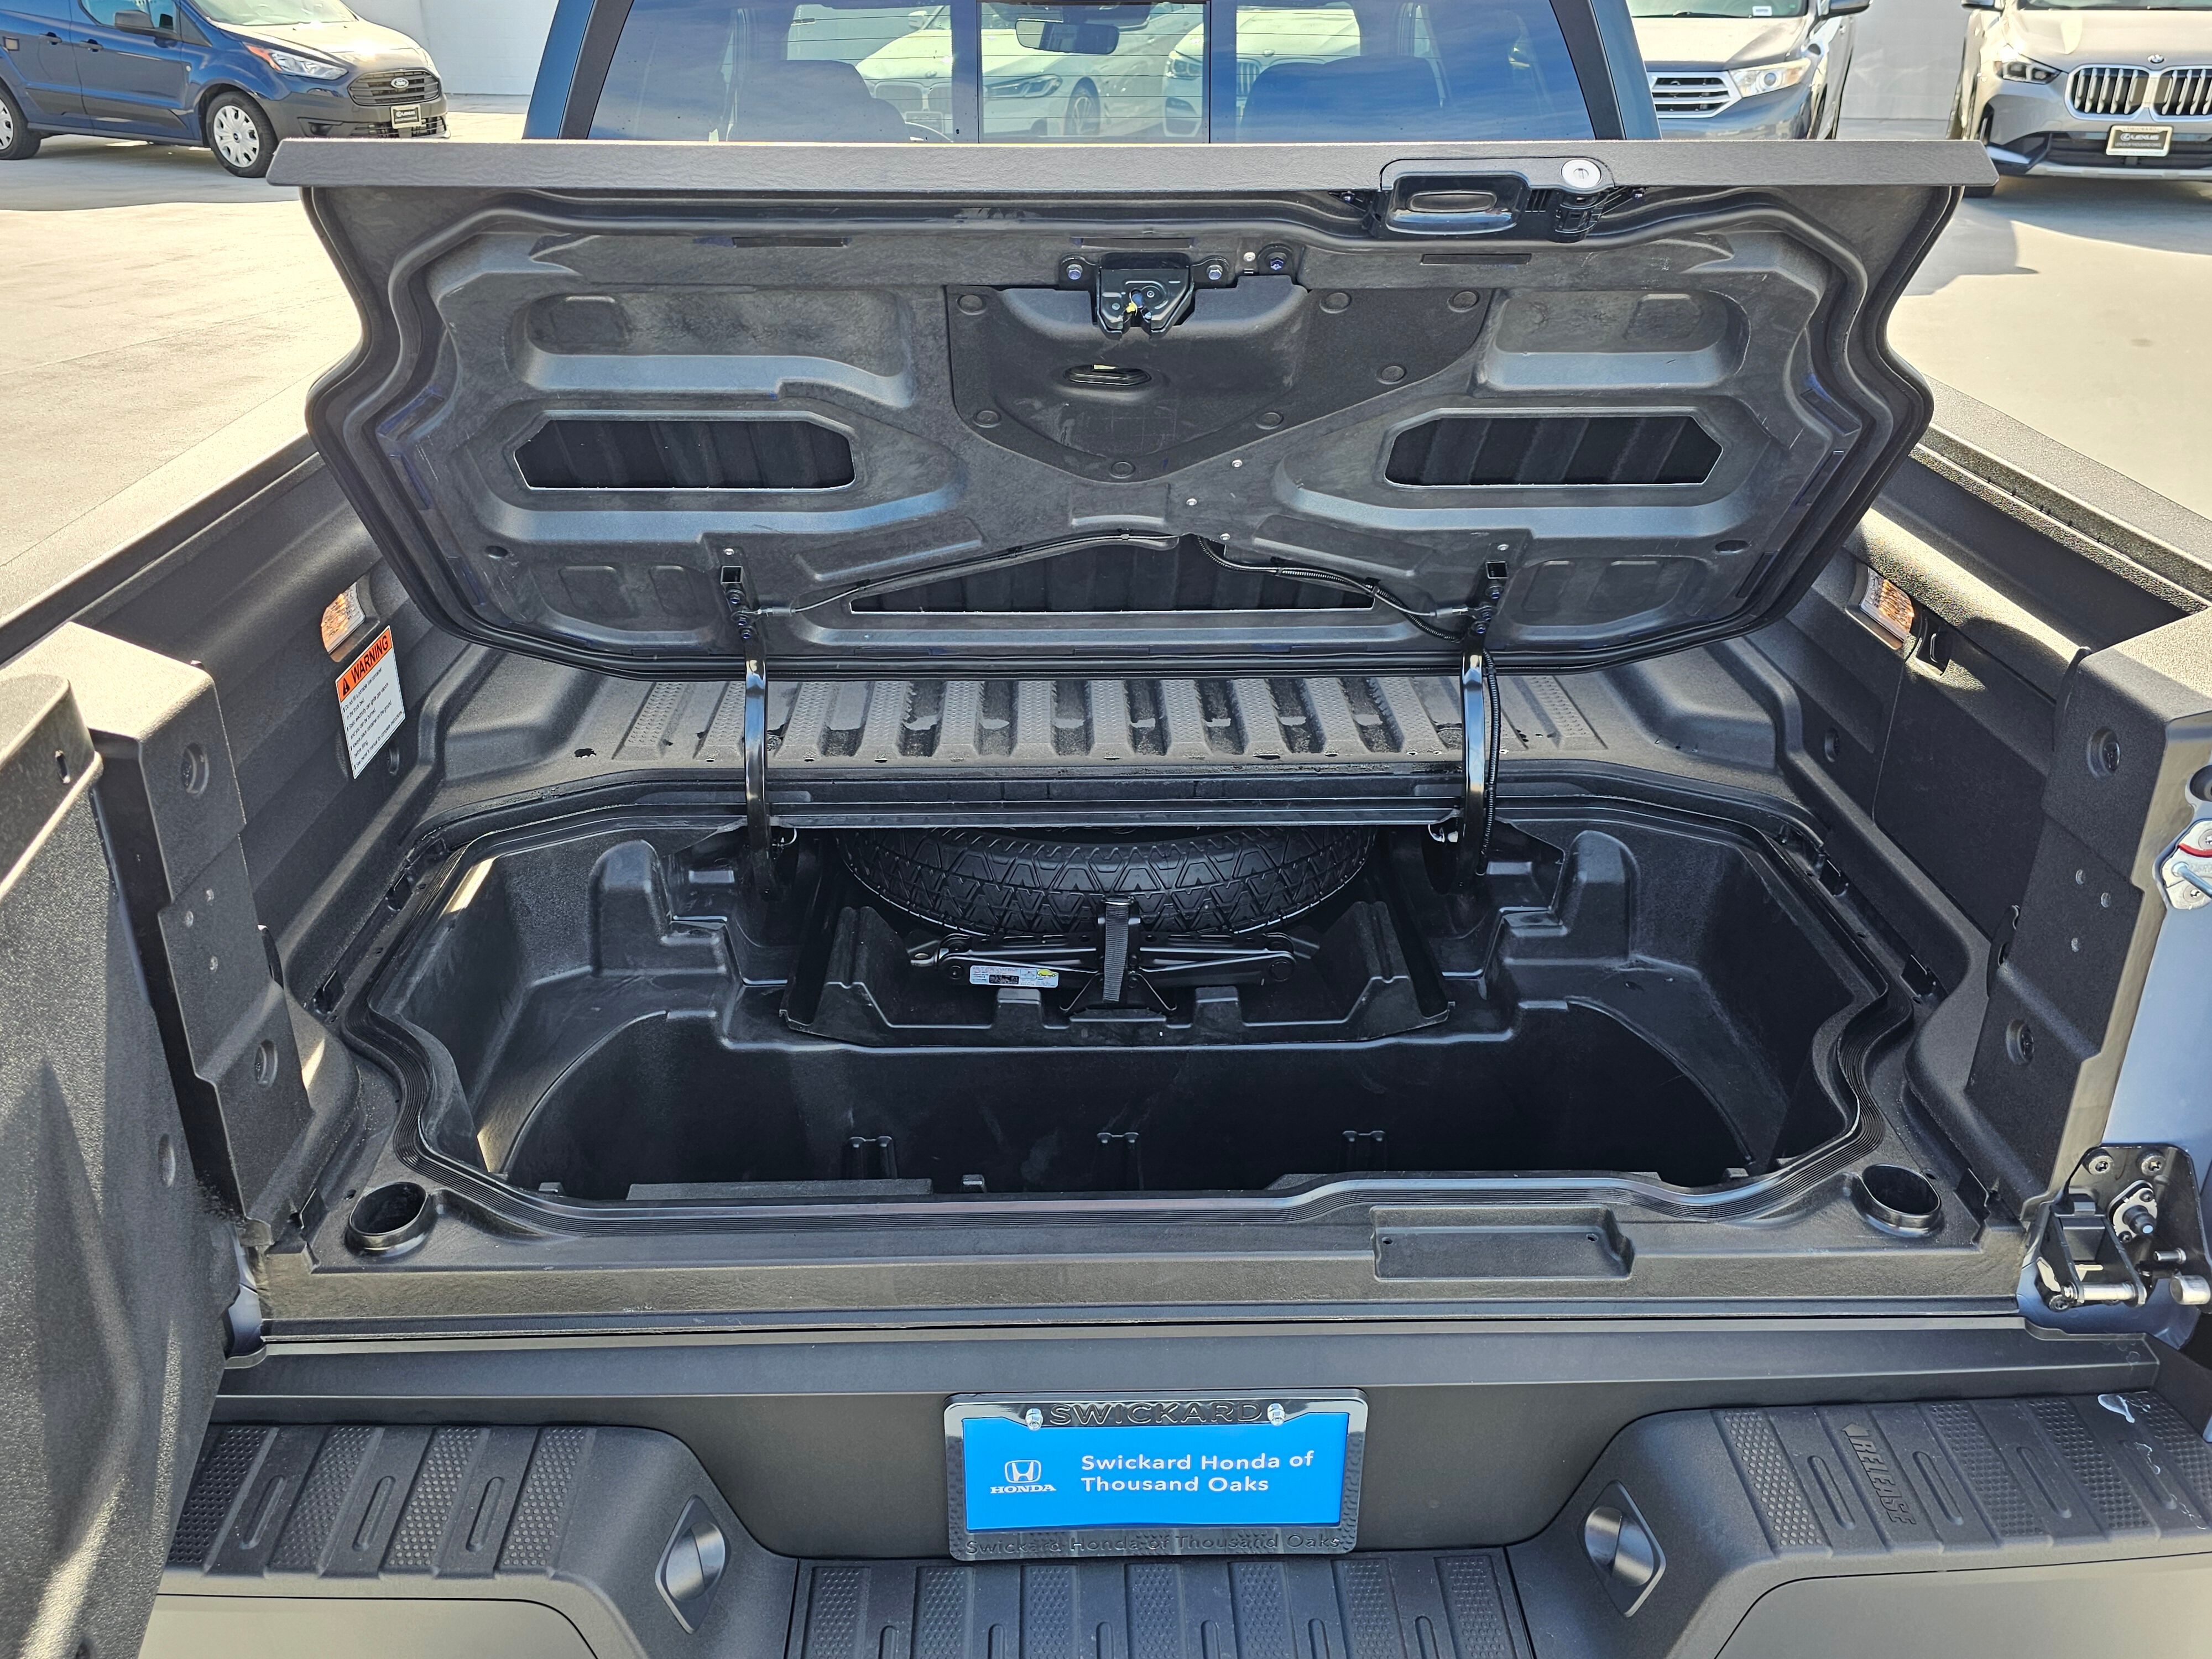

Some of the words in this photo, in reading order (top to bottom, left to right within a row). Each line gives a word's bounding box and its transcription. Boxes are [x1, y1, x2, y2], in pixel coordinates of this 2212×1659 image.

[351, 635, 389, 684] WARNING
[1050, 1402, 1262, 1426] SWICKARD
[1082, 1454, 1191, 1470] Swickard
[1201, 1453, 1280, 1470] Honda
[1289, 1450, 1314, 1467] of
[990, 1484, 1057, 1494] HONDA
[1081, 1476, 1199, 1492] Thousand
[1208, 1476, 1269, 1491] Oaks
[1849, 1438, 1917, 1525] RELEASE
[966, 1537, 1061, 1555] Swickard
[1070, 1535, 1138, 1552] Honda
[1148, 1533, 1170, 1551] of
[1176, 1534, 1279, 1550] Thousand
[1286, 1533, 1340, 1548] Oaks
